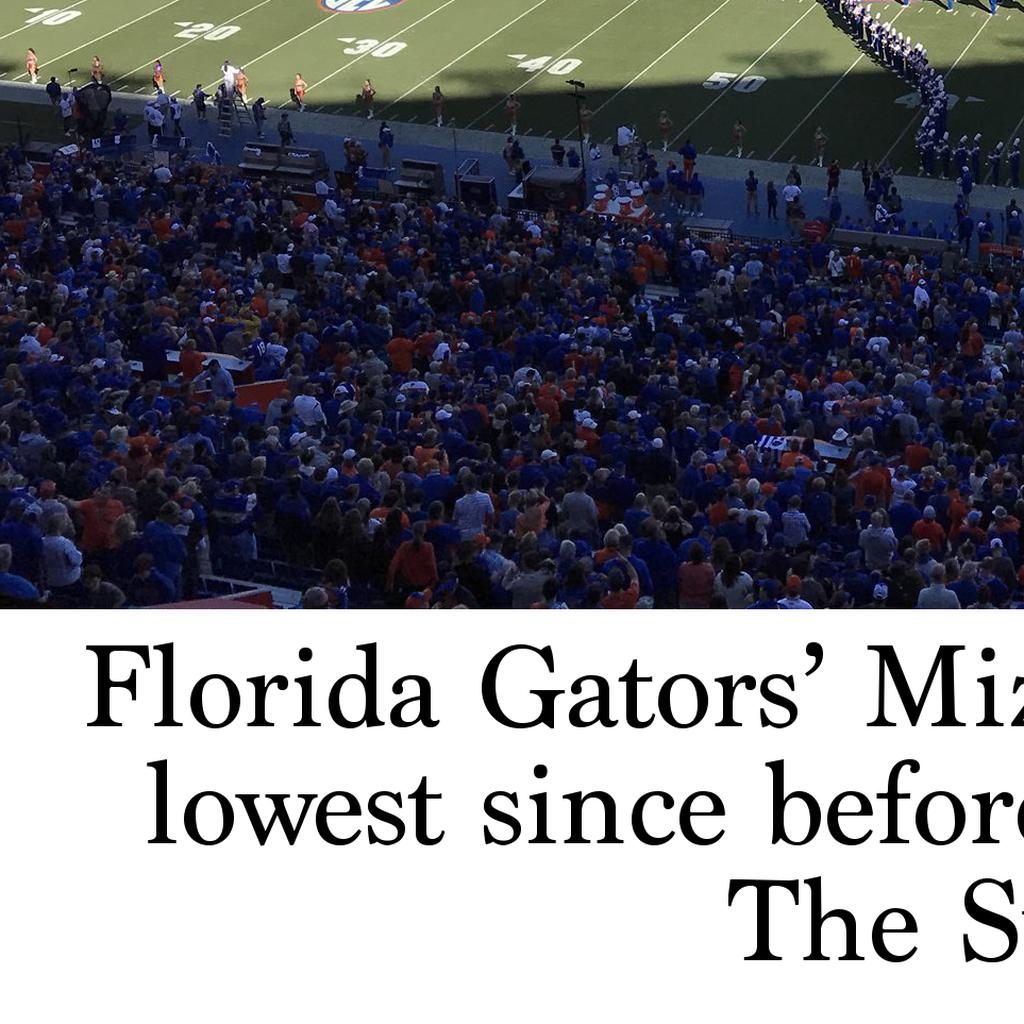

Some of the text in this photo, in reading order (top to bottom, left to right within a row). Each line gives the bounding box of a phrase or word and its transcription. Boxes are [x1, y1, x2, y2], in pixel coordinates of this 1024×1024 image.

[25, 8, 82, 26] 10
[175, 23, 241, 41] 20
[343, 37, 408, 58] 30
[517, 55, 583, 75] 40
[702, 72, 767, 93] 50
